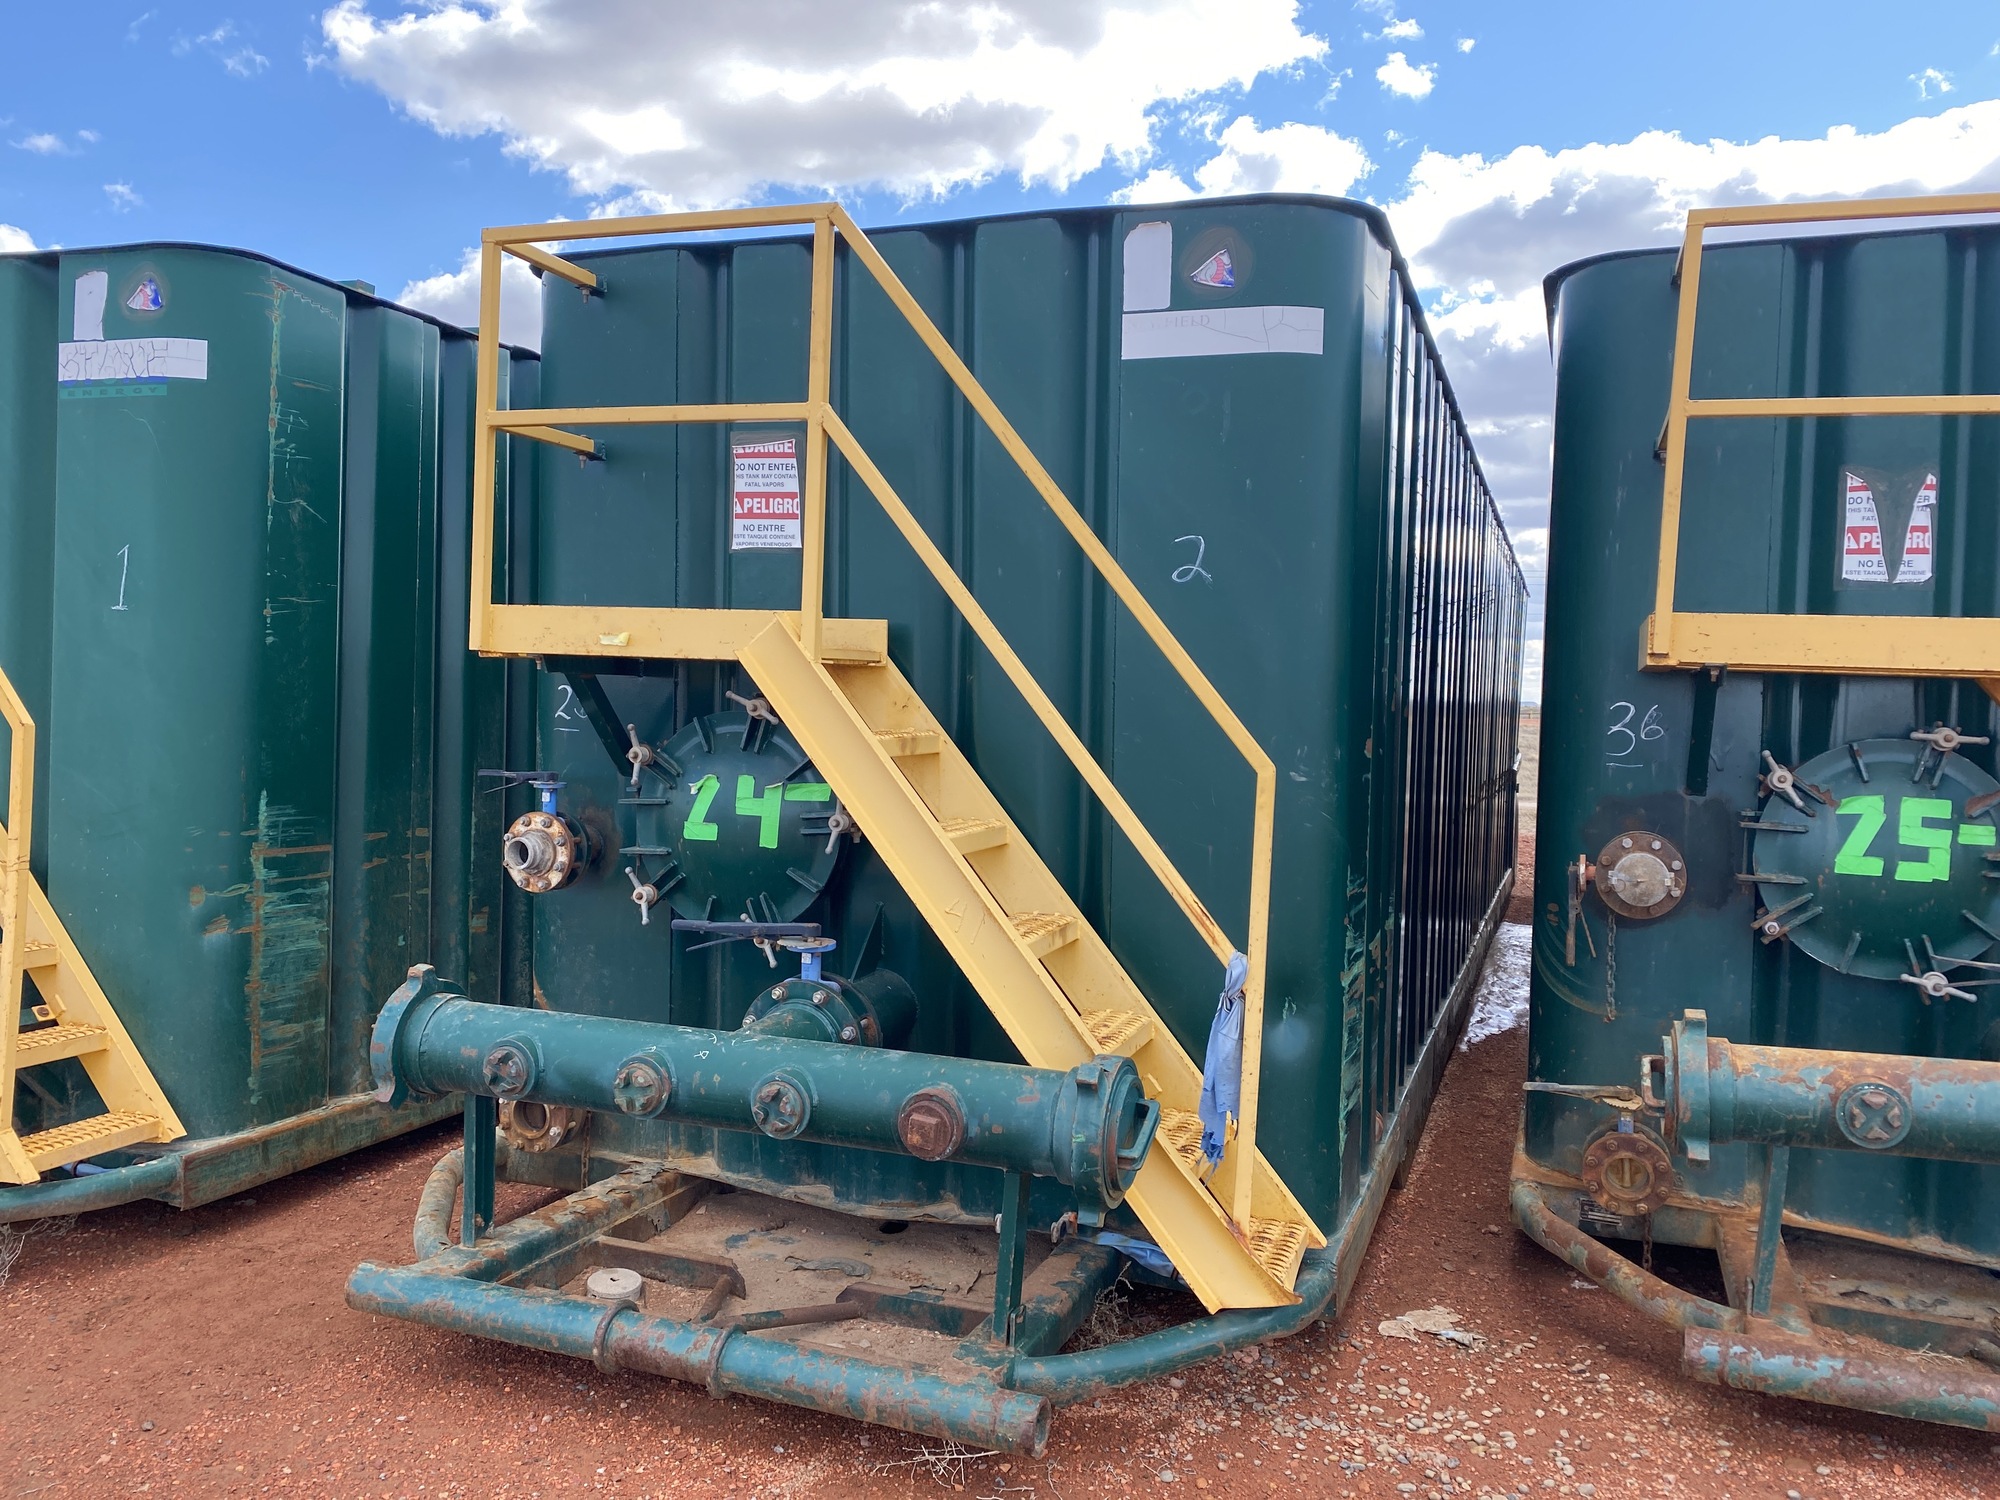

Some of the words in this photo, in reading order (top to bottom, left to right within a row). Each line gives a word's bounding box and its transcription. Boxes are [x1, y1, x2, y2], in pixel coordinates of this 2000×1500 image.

[747, 463, 766, 471] NOT
[768, 463, 796, 471] ENTER
[1848, 496, 1863, 505] DO
[743, 497, 800, 514] PELIGRO
[743, 524, 756, 532] NO
[757, 524, 786, 532] ENTRE
[1171, 535, 1213, 583] 2
[1858, 560, 1874, 568] NO
